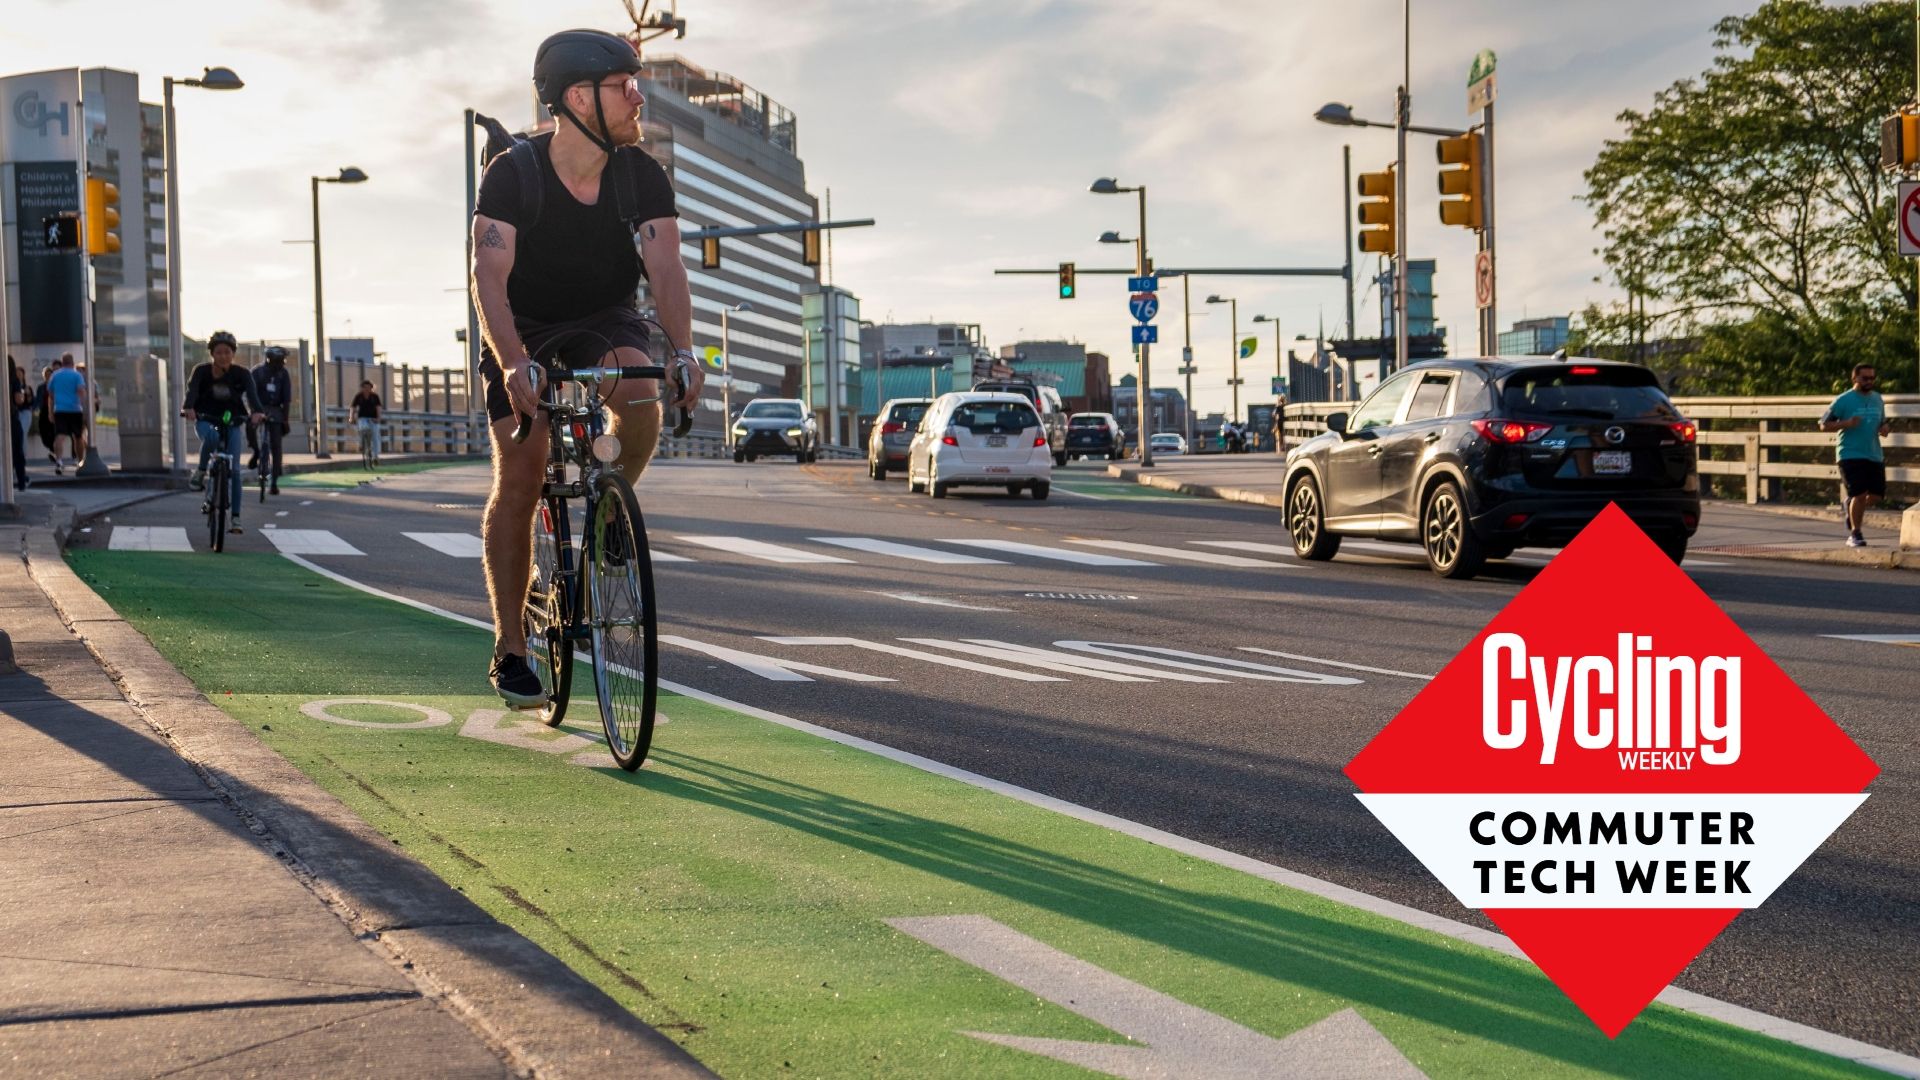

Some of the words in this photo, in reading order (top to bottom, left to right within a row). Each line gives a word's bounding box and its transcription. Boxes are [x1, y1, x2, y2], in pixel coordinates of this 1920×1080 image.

[20, 172, 69, 180] Children's
[21, 185, 62, 194] Hospital
[64, 184, 76, 193] of
[22, 198, 78, 207] Philadelphi
[1136, 280, 1150, 288] TO
[1132, 301, 1155, 317] 76
